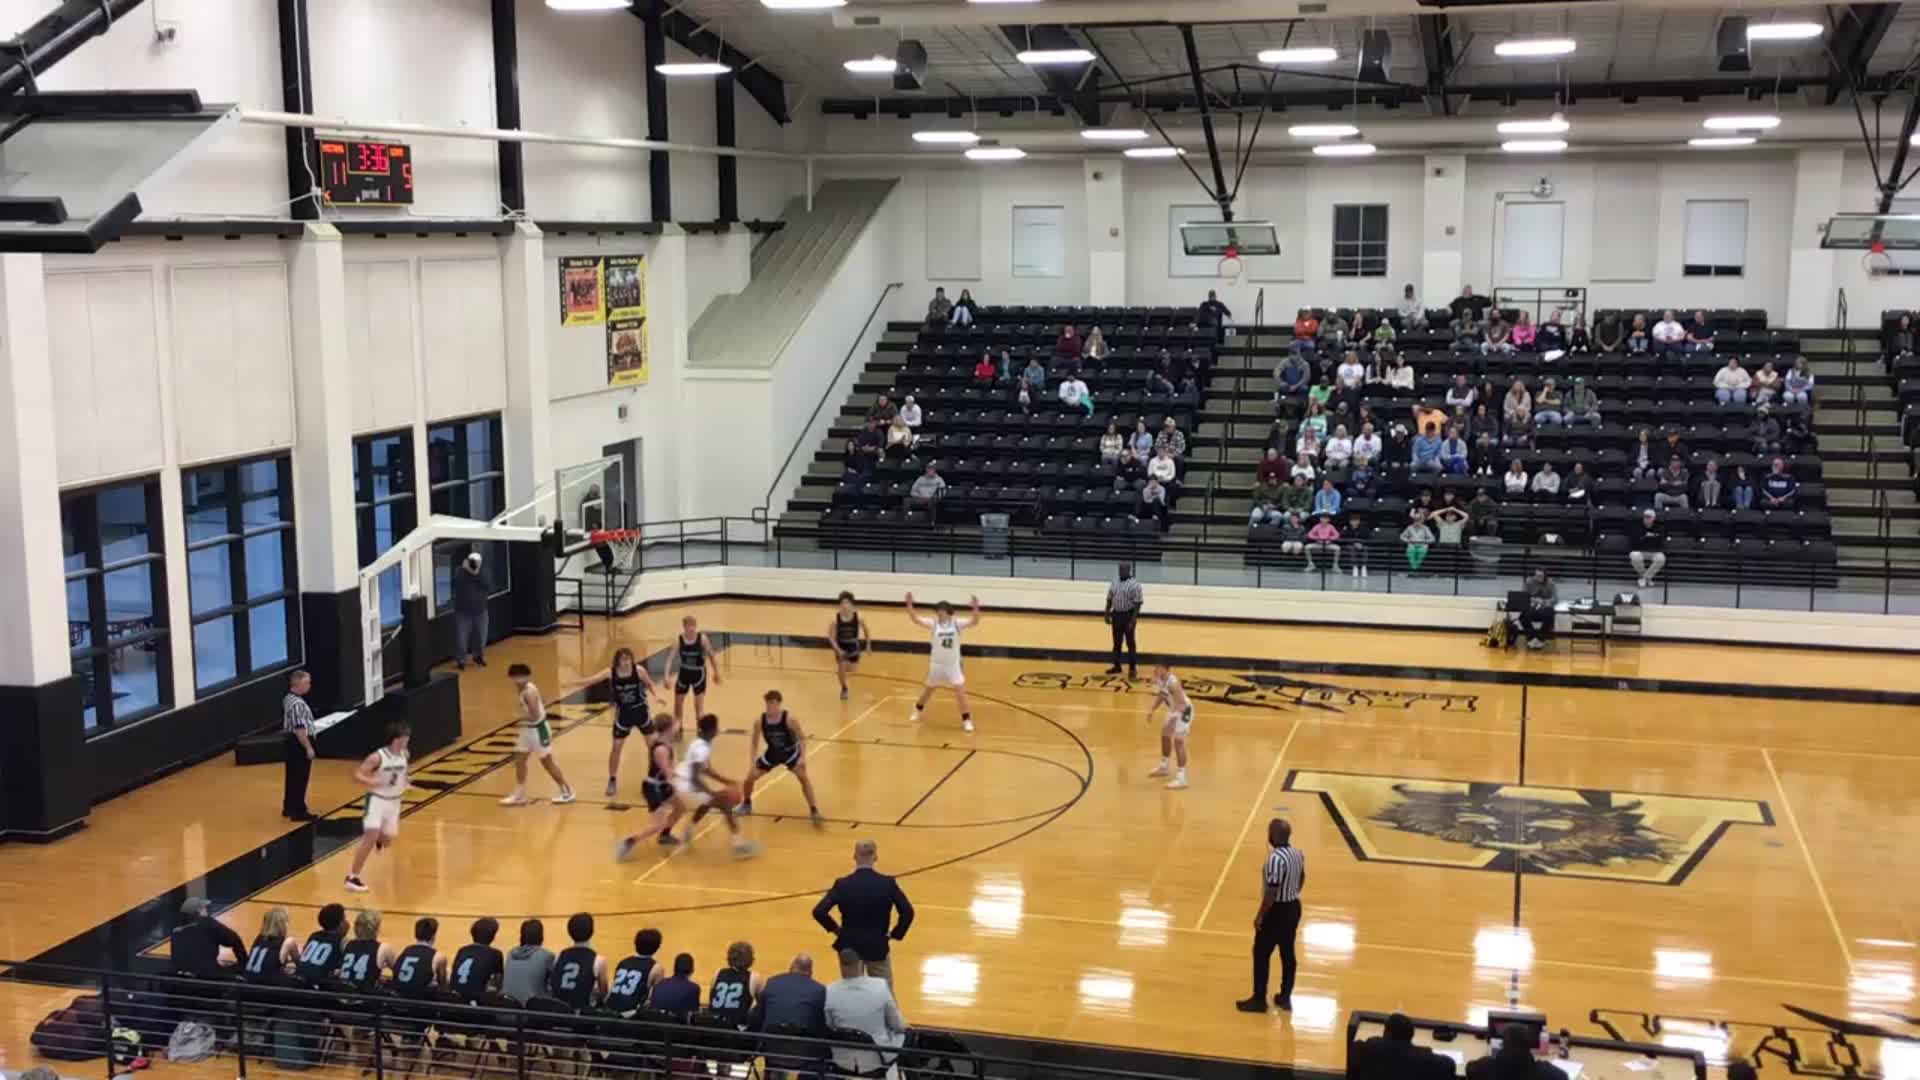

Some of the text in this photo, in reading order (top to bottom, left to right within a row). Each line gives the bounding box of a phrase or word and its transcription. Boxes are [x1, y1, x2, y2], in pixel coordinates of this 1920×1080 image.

[357, 144, 389, 171] 3:36
[332, 160, 347, 185] 11
[402, 162, 413, 190] 5
[246, 946, 268, 973] 11
[300, 940, 333, 965] 00
[340, 953, 370, 980] 24
[398, 956, 419, 983] 5
[457, 958, 474, 984] 4
[561, 962, 580, 989] 2
[610, 968, 642, 996] 23
[712, 982, 744, 1009] 32
